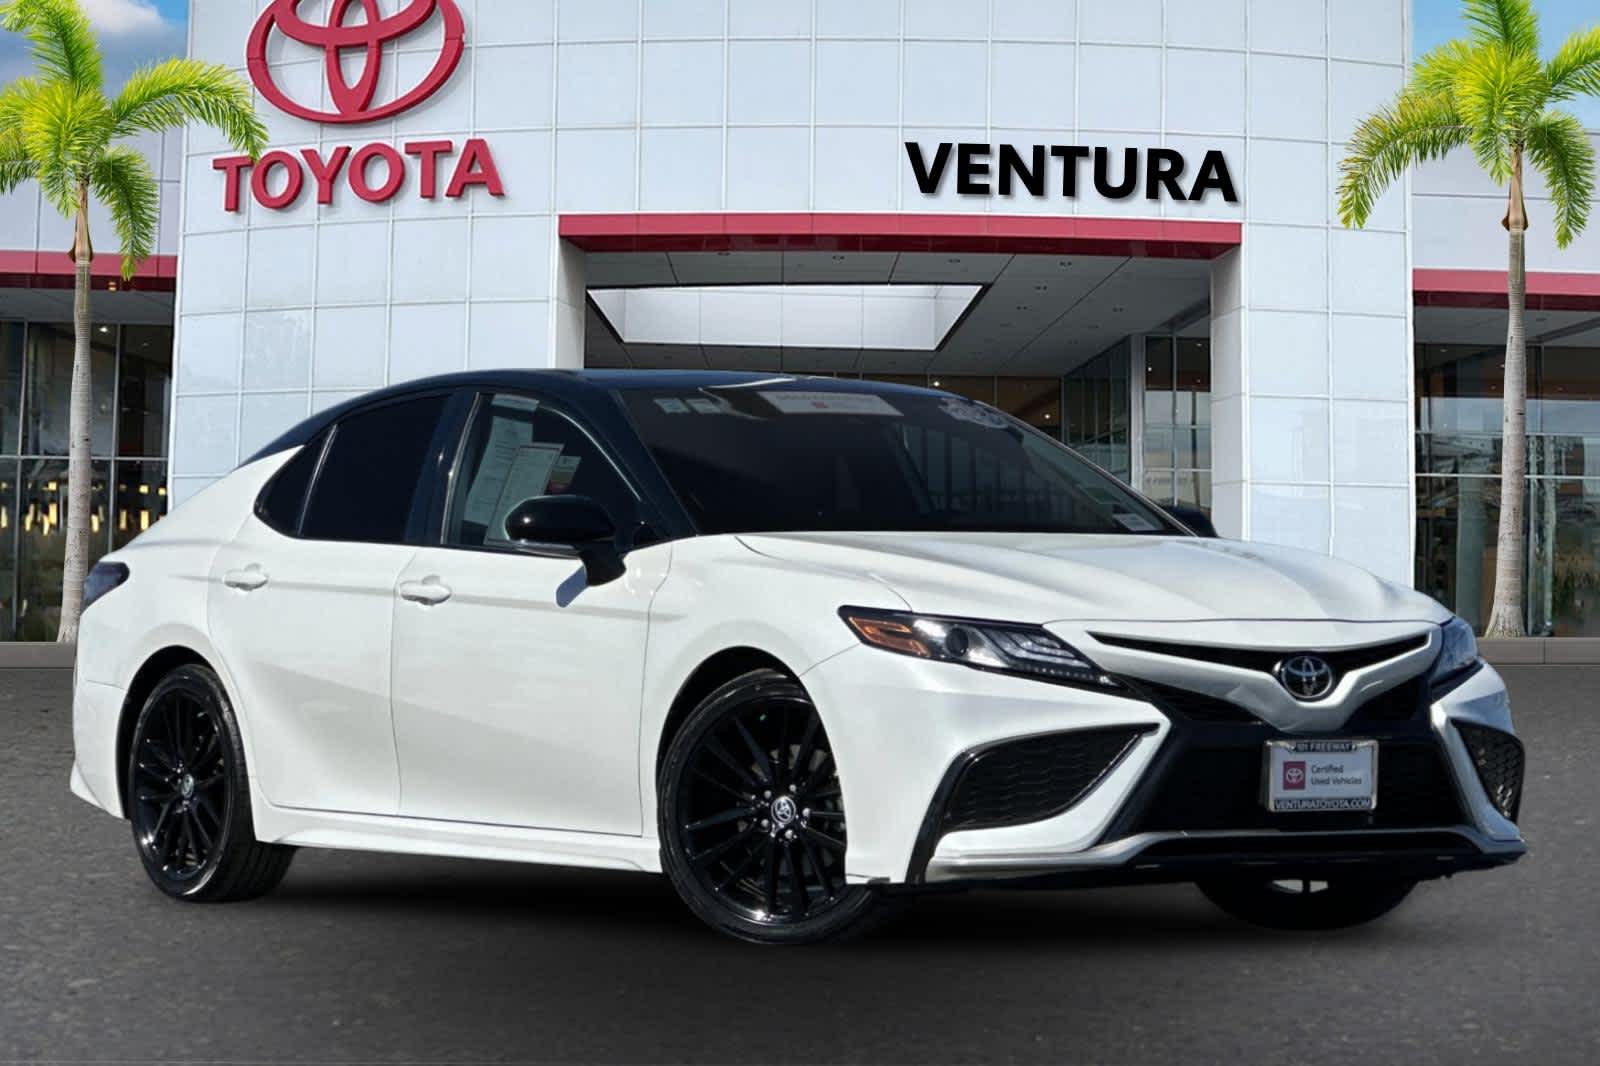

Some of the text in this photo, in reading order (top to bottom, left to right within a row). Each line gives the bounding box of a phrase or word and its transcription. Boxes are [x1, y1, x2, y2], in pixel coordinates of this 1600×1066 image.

[212, 138, 505, 212] TOYOTA
[904, 141, 1239, 203] VENTURA
[1311, 764, 1344, 773] Certified
[1311, 775, 1362, 785] Used Vehicles
